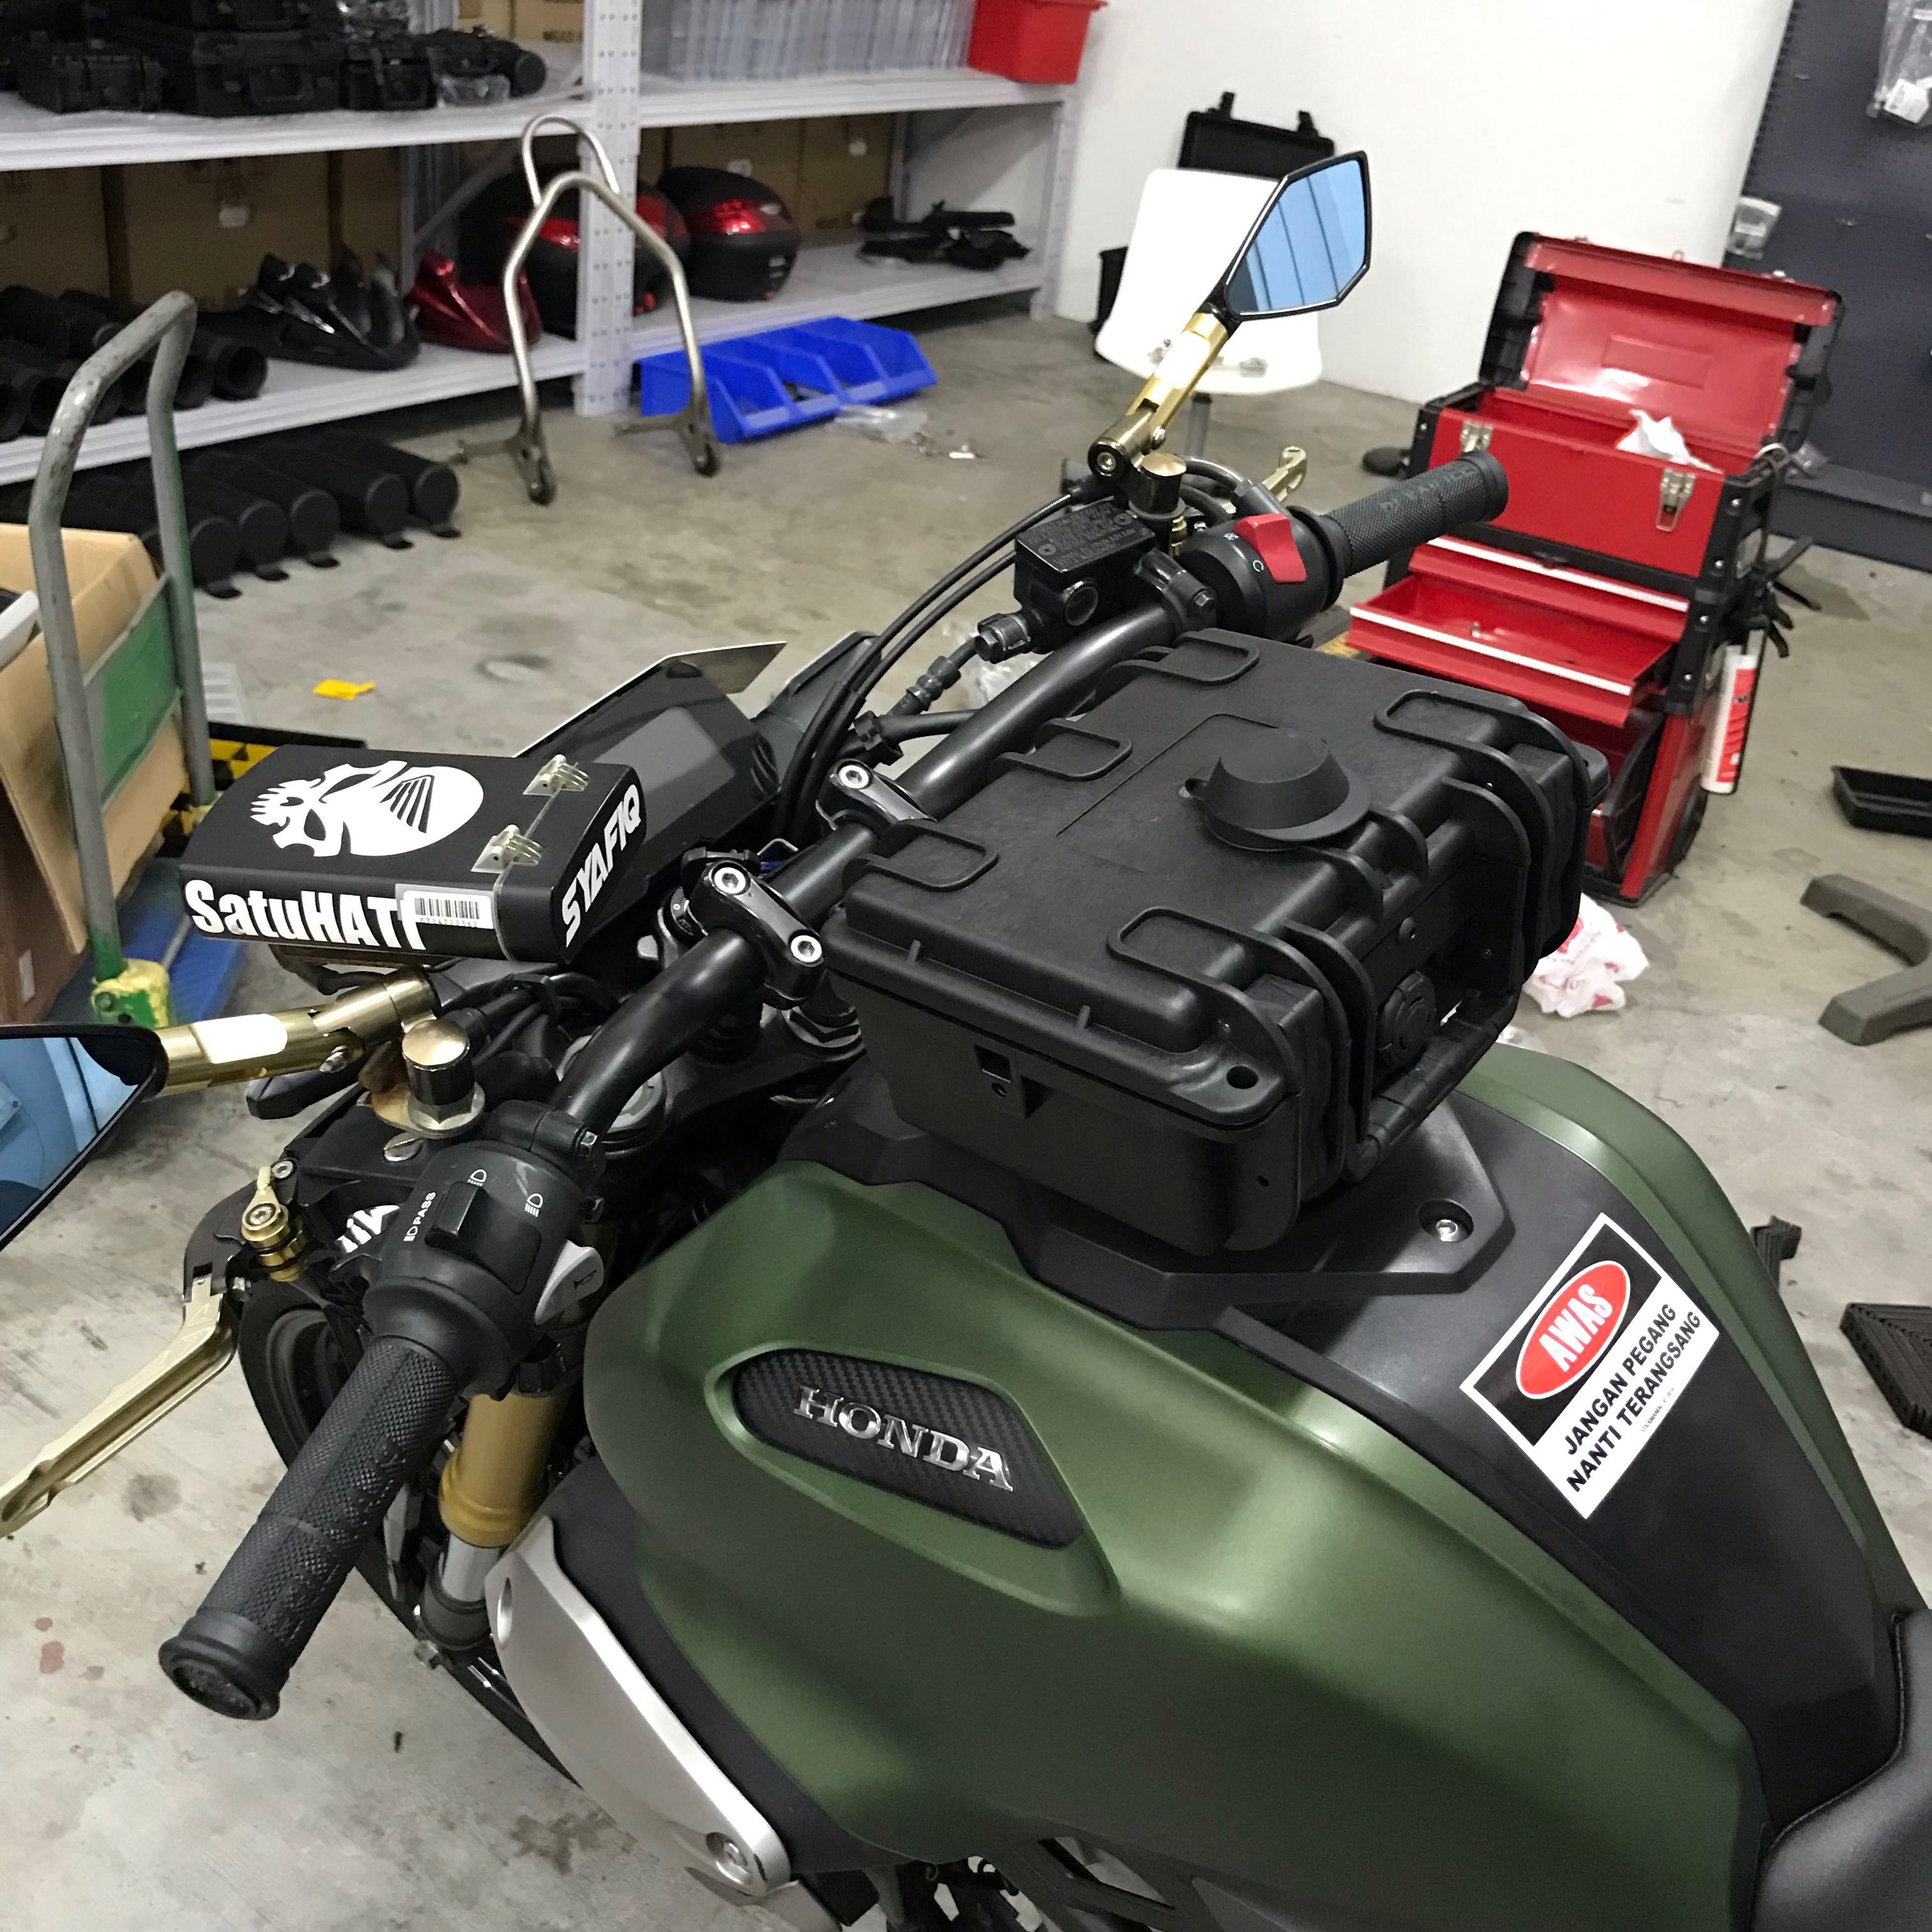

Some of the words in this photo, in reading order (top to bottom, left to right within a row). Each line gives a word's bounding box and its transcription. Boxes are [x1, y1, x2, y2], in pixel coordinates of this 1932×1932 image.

[185, 879, 426, 951] SatuHATI
[562, 785, 641, 947] SYAFIQ
[413, 1192, 436, 1225] PASS
[1538, 1284, 1613, 1372] AWAS
[1565, 1372, 1629, 1455] JANGAN
[1622, 1304, 1676, 1376] PEGANG
[793, 1385, 1014, 1492] HONDA
[1567, 1425, 1622, 1492] NANTI
[1616, 1311, 1701, 1426] TERANGSANG
